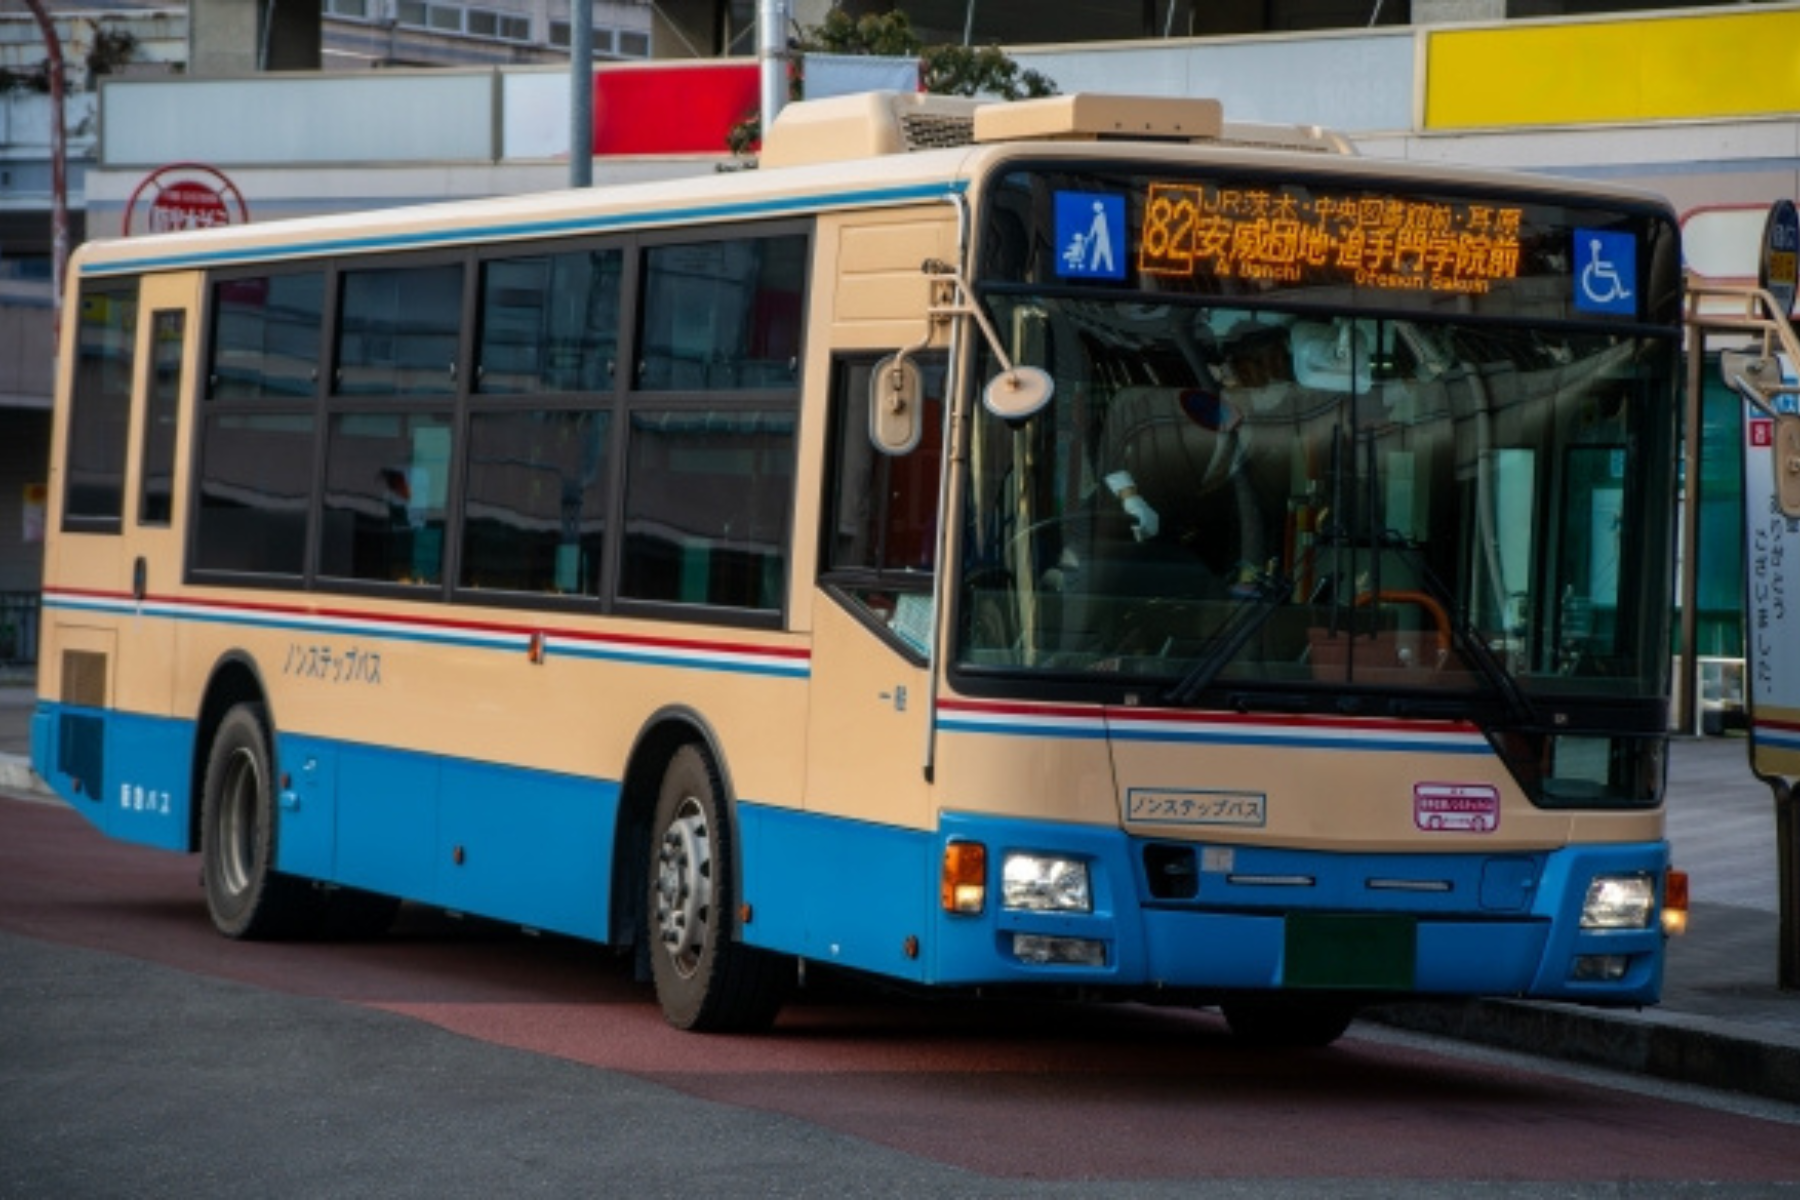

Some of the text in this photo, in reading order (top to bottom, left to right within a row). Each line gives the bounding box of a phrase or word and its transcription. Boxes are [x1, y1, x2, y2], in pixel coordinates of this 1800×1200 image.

[1147, 197, 1195, 259] 82
[283, 642, 382, 685] ノンステップバス
[1132, 796, 1261, 819] ノンステップバス
